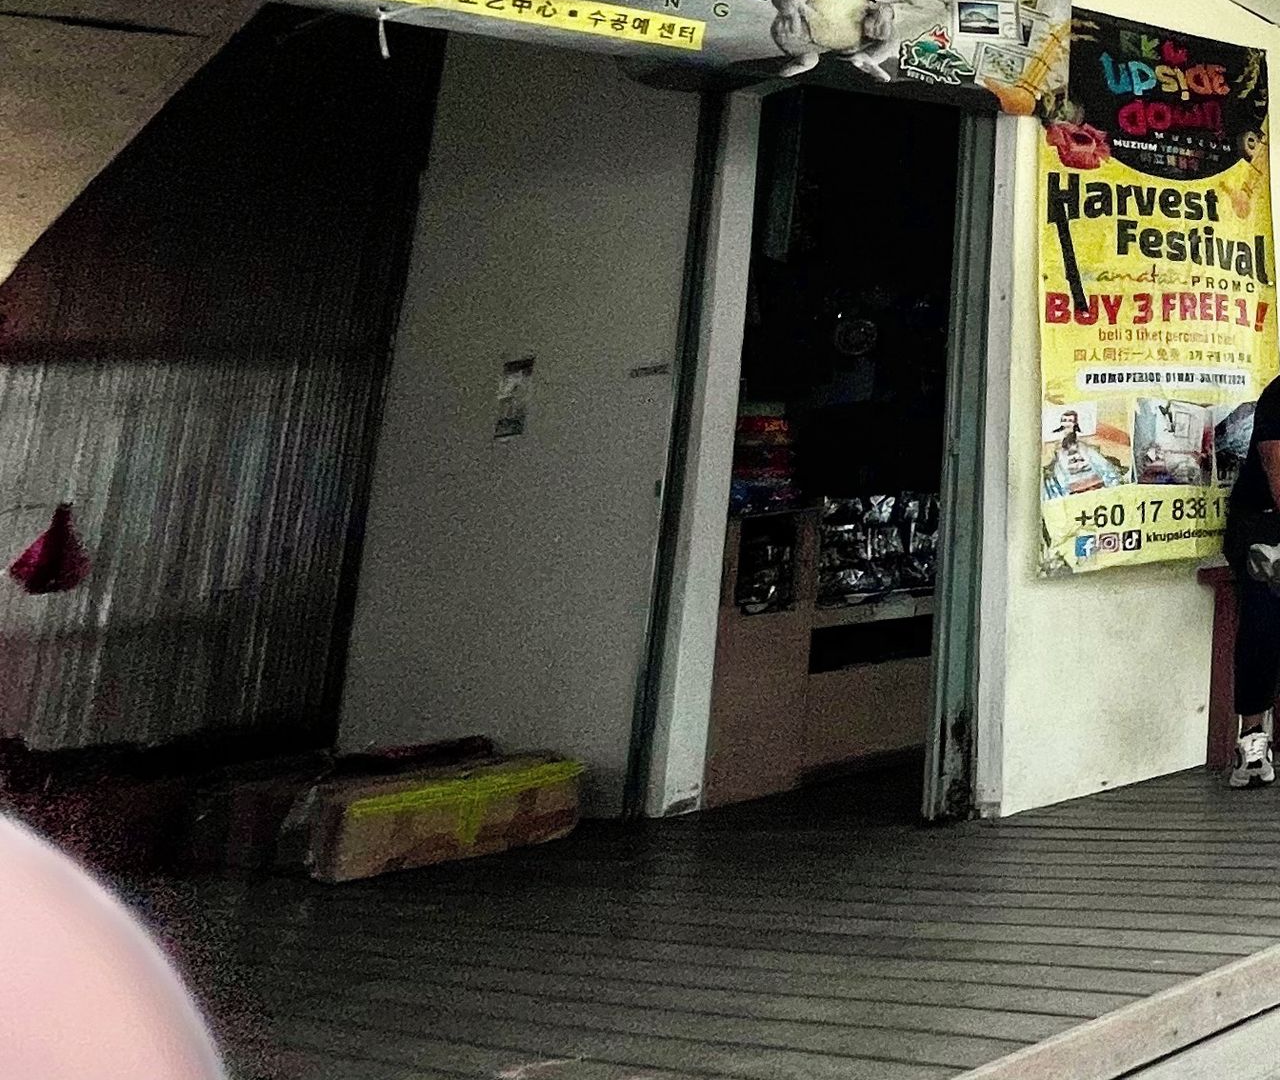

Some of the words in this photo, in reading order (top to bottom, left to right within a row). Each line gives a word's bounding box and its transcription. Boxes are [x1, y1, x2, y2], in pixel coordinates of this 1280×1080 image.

[1047, 171, 1220, 223] Harvest
[1116, 219, 1272, 286] Festival
[1045, 291, 1123, 326] BUY
[1132, 293, 1154, 324] 3
[1161, 291, 1230, 323] FREE
[1075, 503, 1125, 528] +60
[1136, 500, 1163, 524] 17
